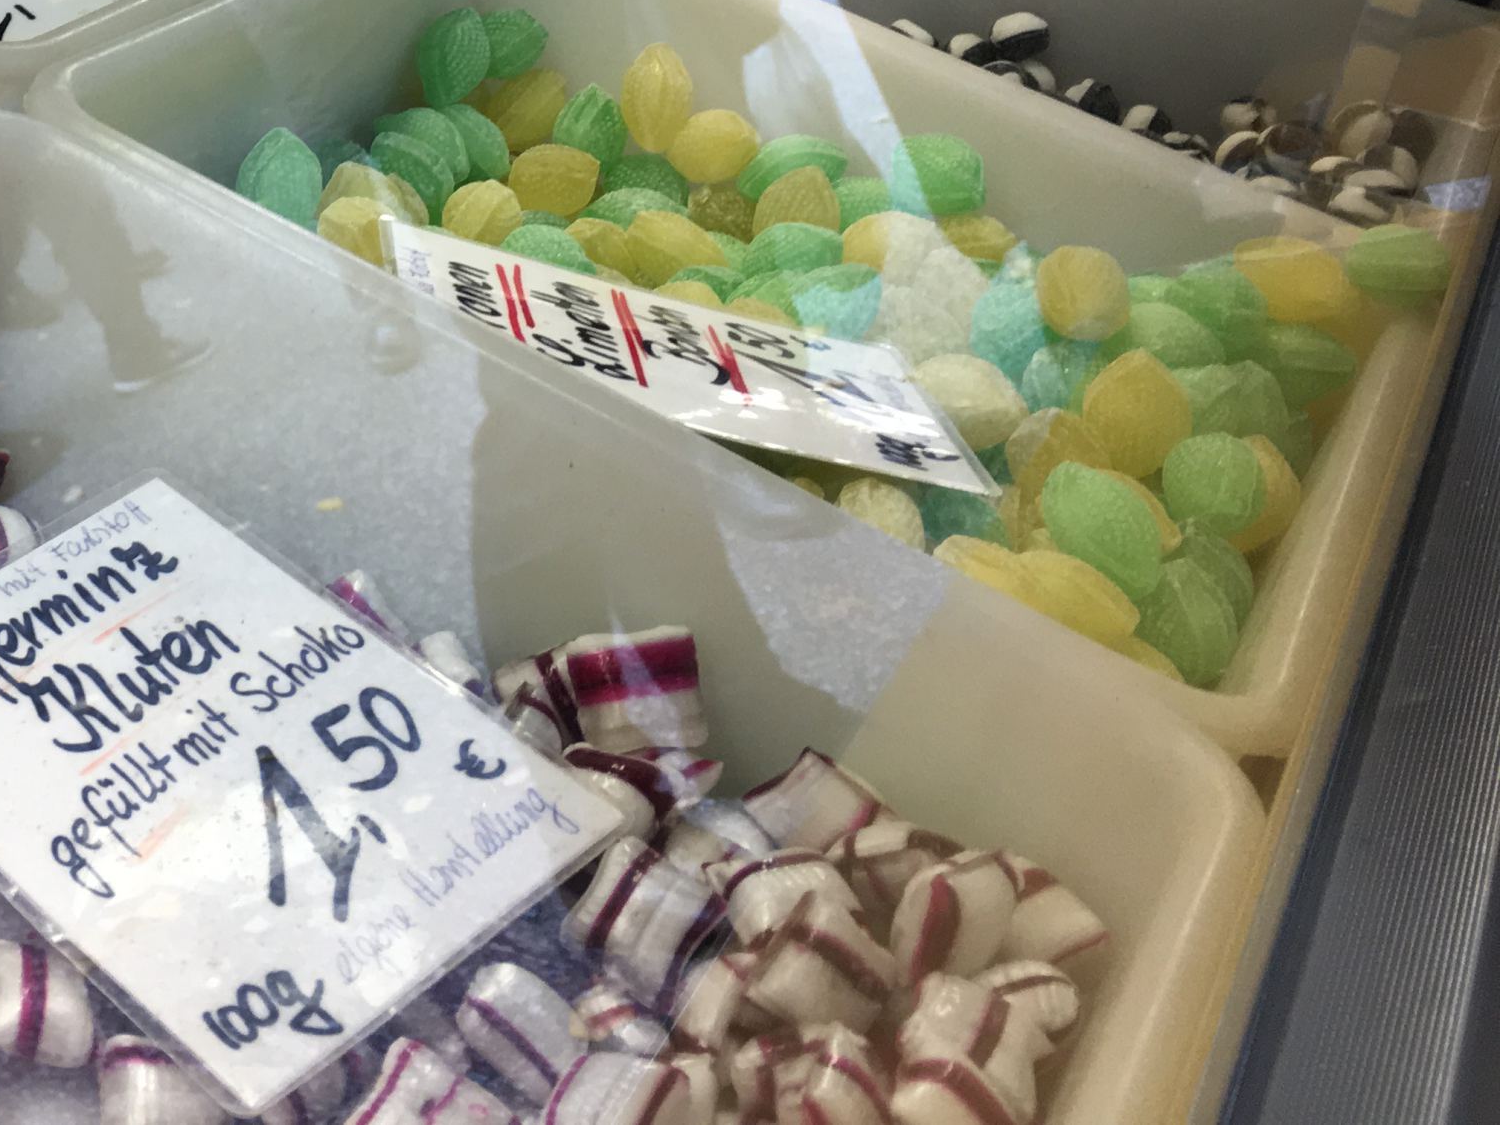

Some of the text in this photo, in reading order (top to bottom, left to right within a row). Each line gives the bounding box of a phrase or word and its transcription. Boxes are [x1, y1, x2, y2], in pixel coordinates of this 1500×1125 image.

[28, 617, 240, 753] Kluten
[51, 621, 365, 898] gefüllt mit Schoko
[453, 739, 507, 779] €
[202, 969, 344, 1050] 100g
